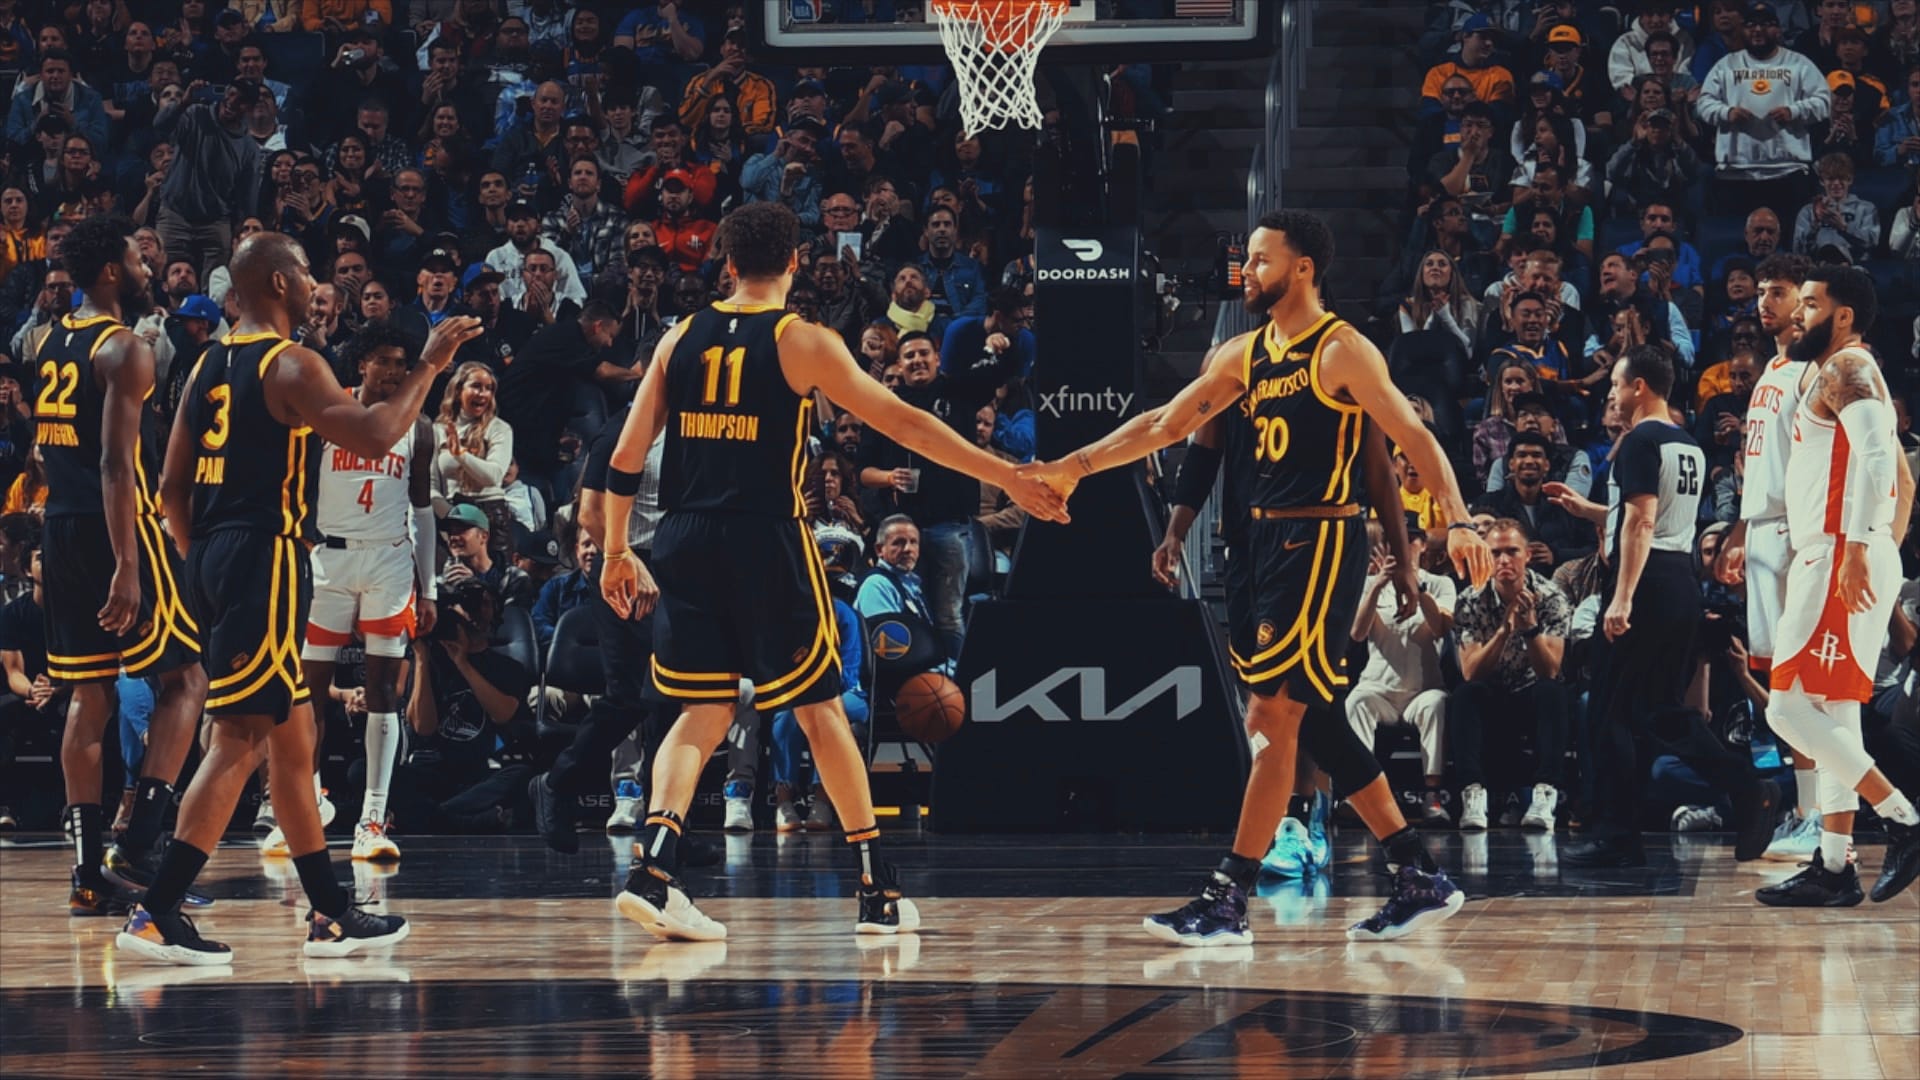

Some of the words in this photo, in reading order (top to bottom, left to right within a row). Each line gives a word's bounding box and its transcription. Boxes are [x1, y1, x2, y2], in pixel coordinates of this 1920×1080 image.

[1733, 68, 1791, 87] WARRIORS
[1037, 268, 1130, 281] DOORDASH
[34, 359, 80, 418] 22
[700, 345, 747, 408] 11
[200, 383, 232, 450] 3
[1039, 385, 1135, 418] xfinity
[679, 411, 760, 442] THOMPSON
[1254, 415, 1290, 463] 30
[1677, 453, 1698, 496] 52
[357, 479, 374, 514] 4
